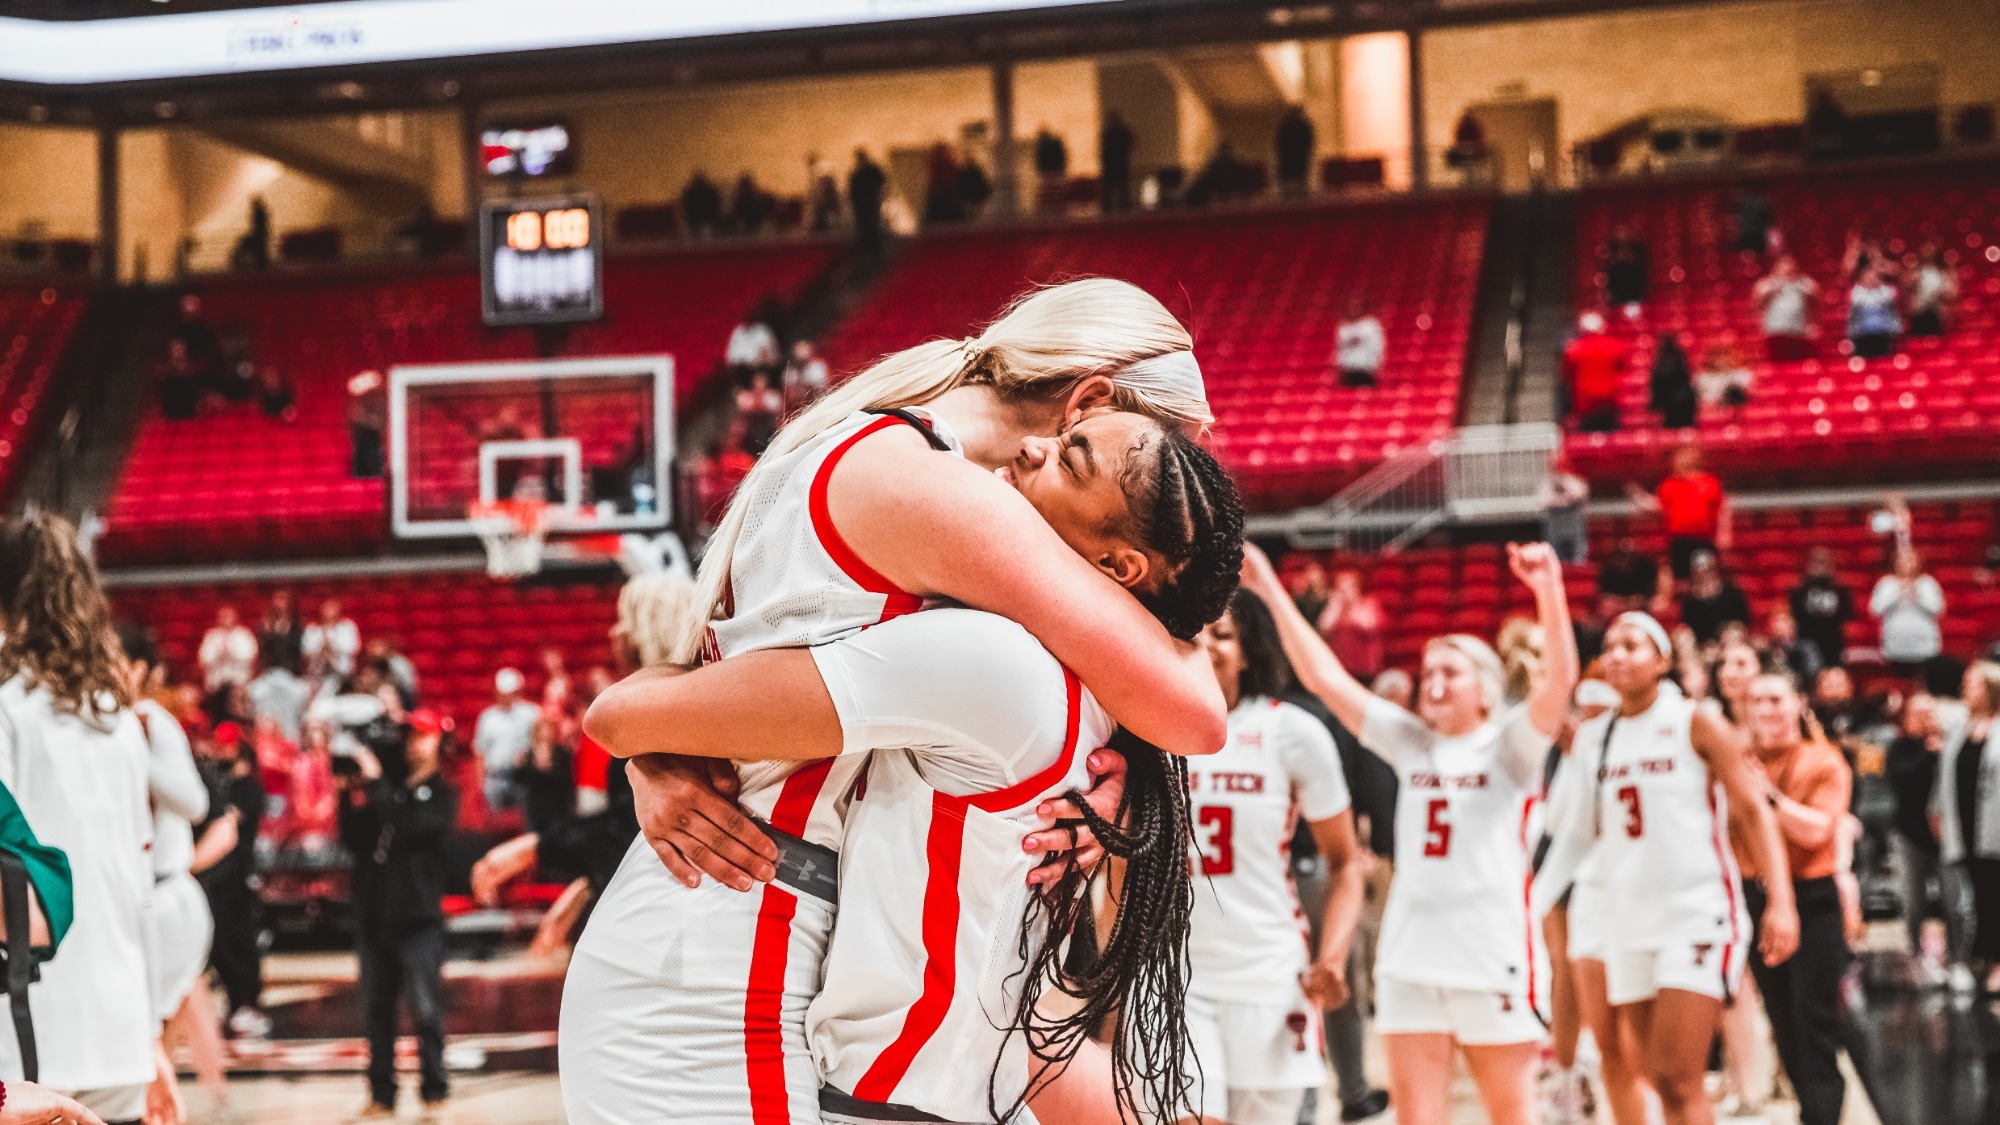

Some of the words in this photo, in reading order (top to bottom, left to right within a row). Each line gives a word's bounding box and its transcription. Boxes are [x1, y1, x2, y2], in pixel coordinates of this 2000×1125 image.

[1424, 799, 1452, 856] 5
[1617, 786, 1642, 838] 3
[1188, 806, 1233, 876] 3
